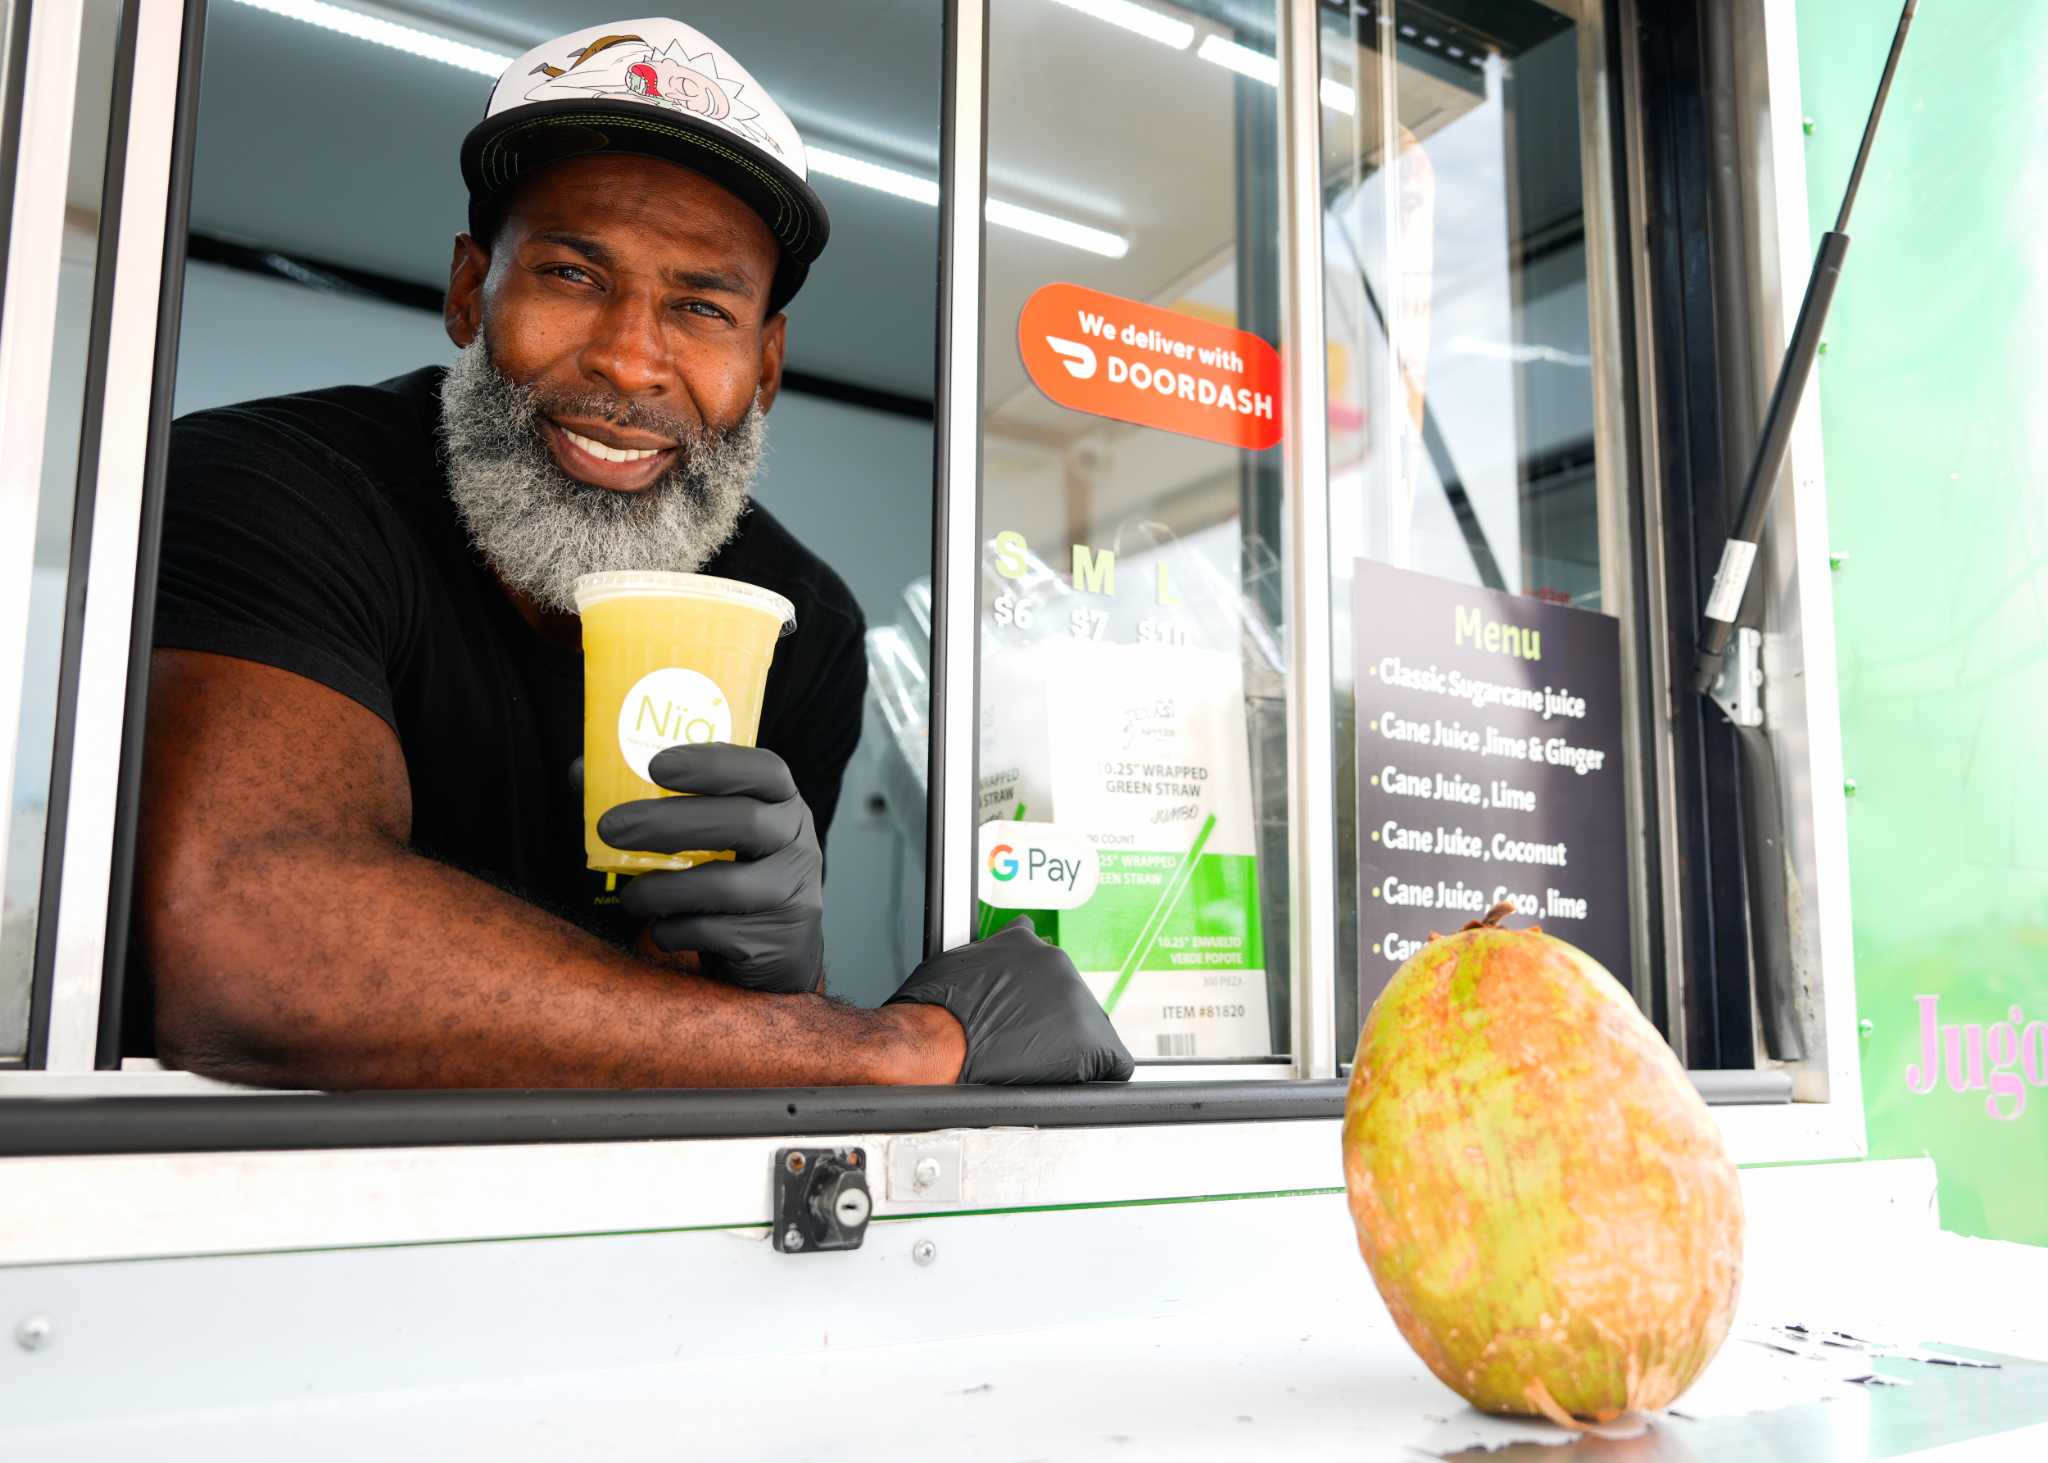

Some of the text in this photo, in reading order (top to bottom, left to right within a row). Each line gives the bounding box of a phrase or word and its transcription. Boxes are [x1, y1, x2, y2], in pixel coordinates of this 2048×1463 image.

[1078, 310, 1244, 373] We deliver with
[1108, 355, 1273, 420] DOORDASH
[995, 530, 1184, 605] S M L
[993, 592, 1034, 631] $6
[1071, 604, 1110, 642] $7
[1455, 604, 1541, 661] Menu
[1380, 657, 1586, 719] Classic Sugarcane juice
[1381, 711, 1431, 744] Cane
[1432, 719, 1480, 752] Juice
[1529, 737, 1544, 761] &
[1546, 738, 1605, 775] Ginger
[1106, 780, 1201, 797] GREEN STRAW
[1142, 764, 1208, 781] WRAPPED
[1381, 765, 1432, 798] Cane
[1433, 773, 1481, 805] Juice
[1491, 780, 1536, 812] Lime
[1382, 820, 1433, 851] Cane
[1434, 826, 1482, 858] Juice
[1492, 833, 1567, 866] Coconut
[988, 845, 1082, 892] G Pay
[1383, 876, 1434, 907] Cane
[1435, 881, 1483, 911] Juice
[1384, 932, 1429, 961] Can
[1163, 1005, 1196, 1019] ITEM
